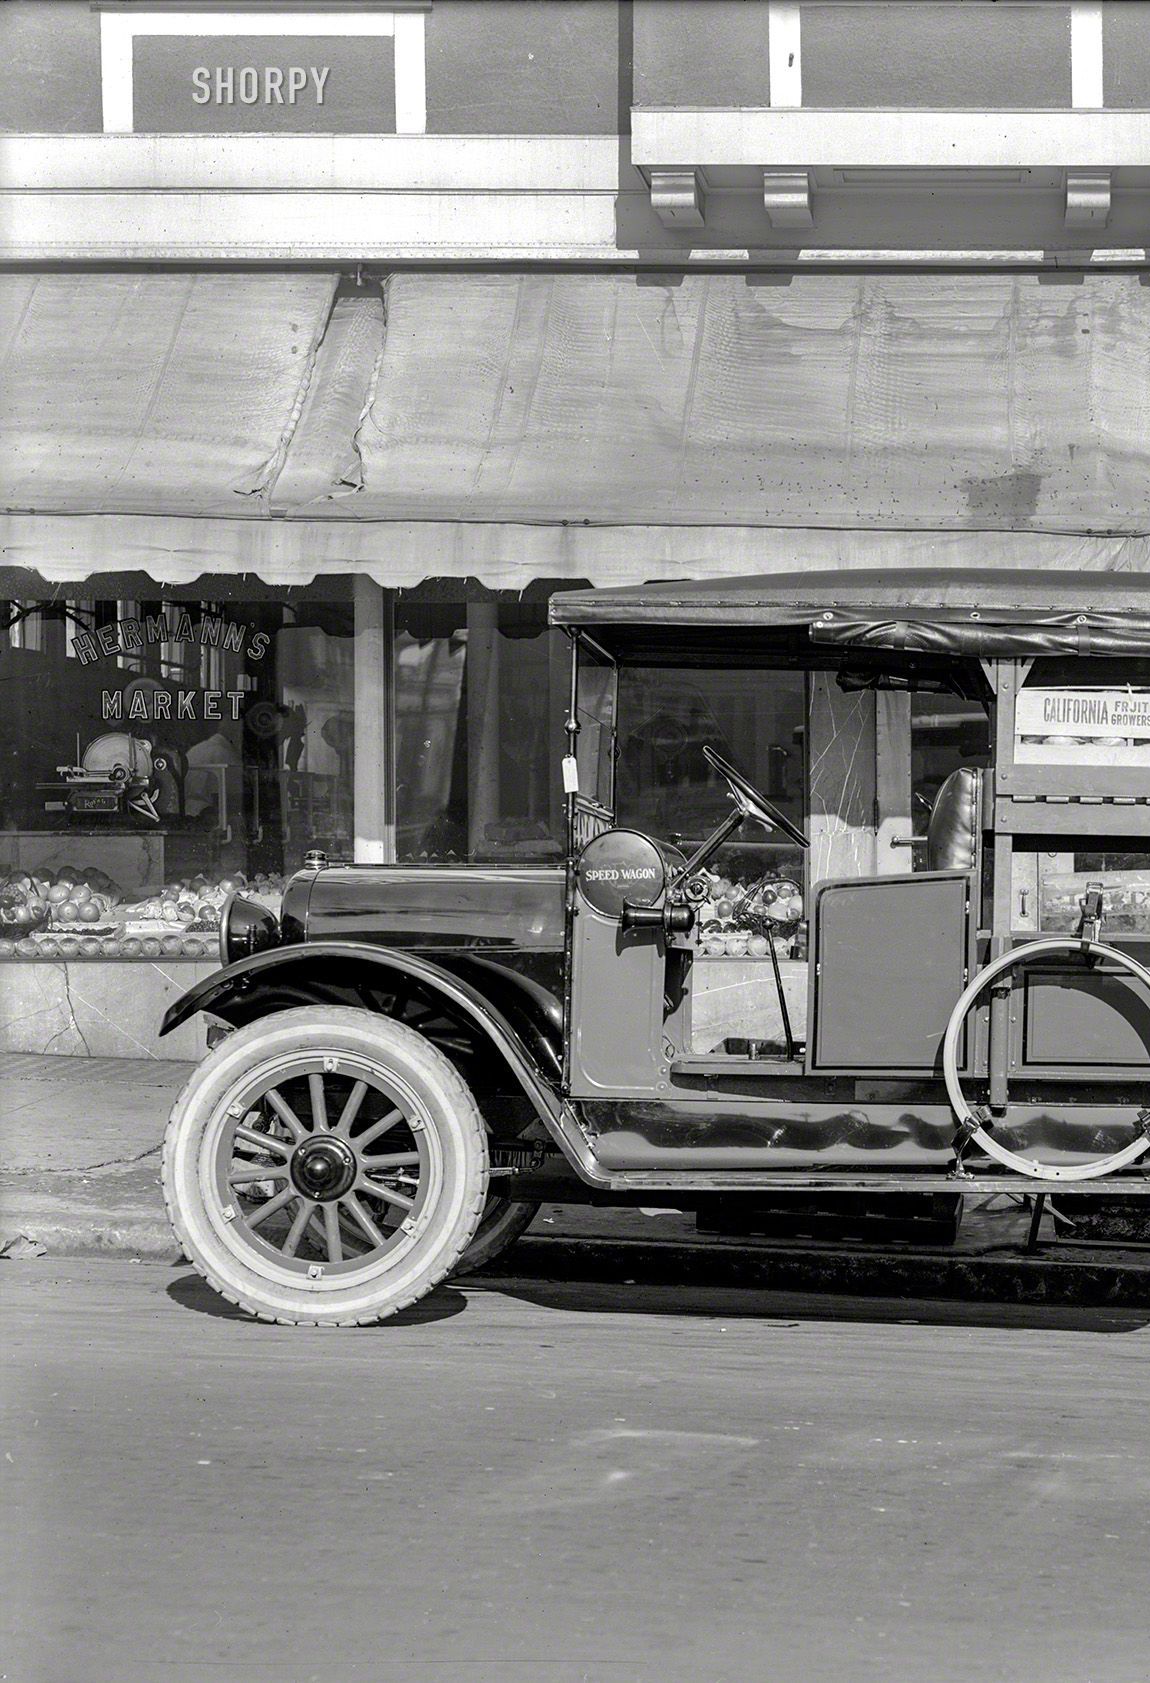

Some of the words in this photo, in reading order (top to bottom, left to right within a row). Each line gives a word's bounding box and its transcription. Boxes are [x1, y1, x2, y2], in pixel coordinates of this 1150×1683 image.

[71, 613, 271, 666] HERMANN'S
[101, 690, 245, 720] MARKET
[1043, 697, 1109, 723] CALIFORNIA
[585, 869, 619, 882] SPEED
[620, 868, 656, 880] WAGON
